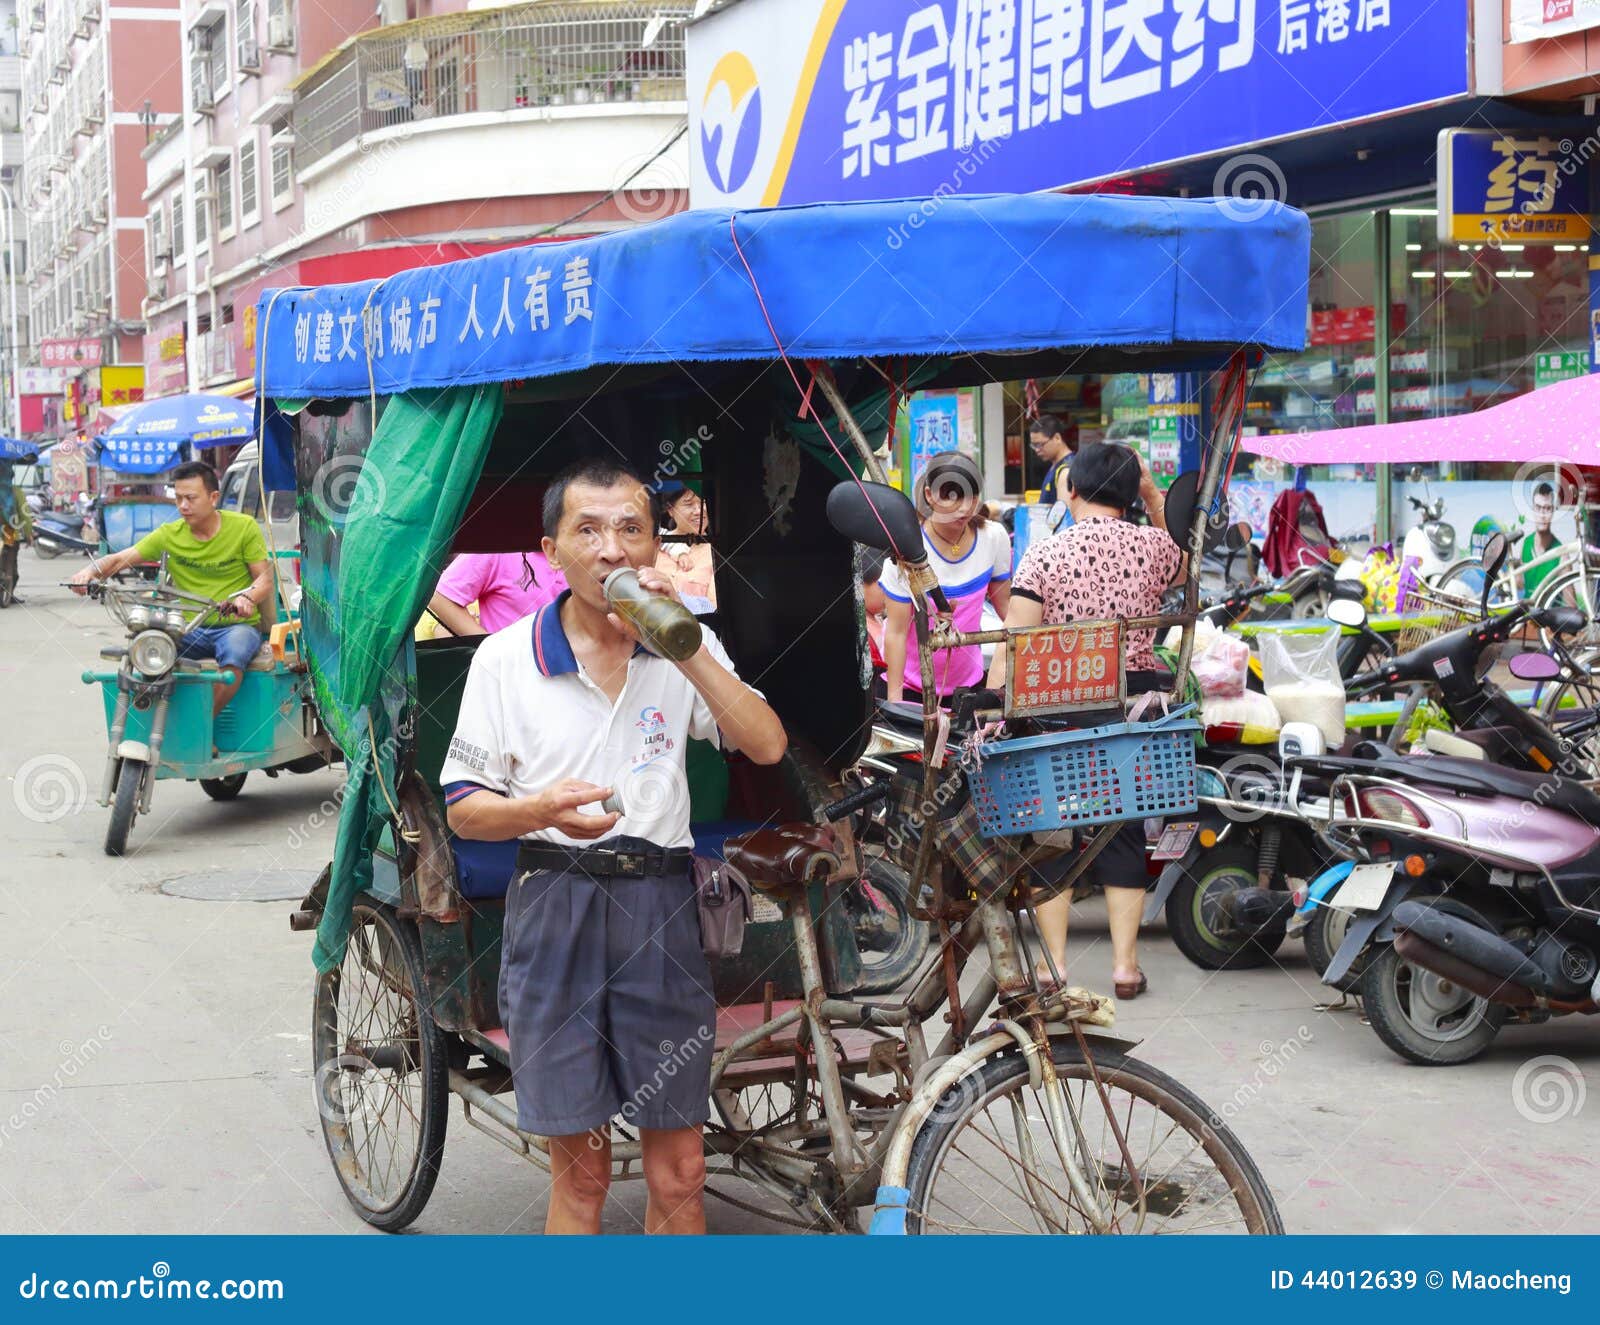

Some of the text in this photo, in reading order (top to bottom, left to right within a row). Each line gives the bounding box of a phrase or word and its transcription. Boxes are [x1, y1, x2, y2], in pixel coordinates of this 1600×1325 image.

[1484, 136, 1560, 213] 药
[294, 290, 441, 364] 创建文明城市
[459, 255, 593, 343] 人人有责
[915, 415, 952, 443] 万艾可
[1021, 627, 1115, 656] 人力 营运
[1047, 655, 1106, 684] 9189
